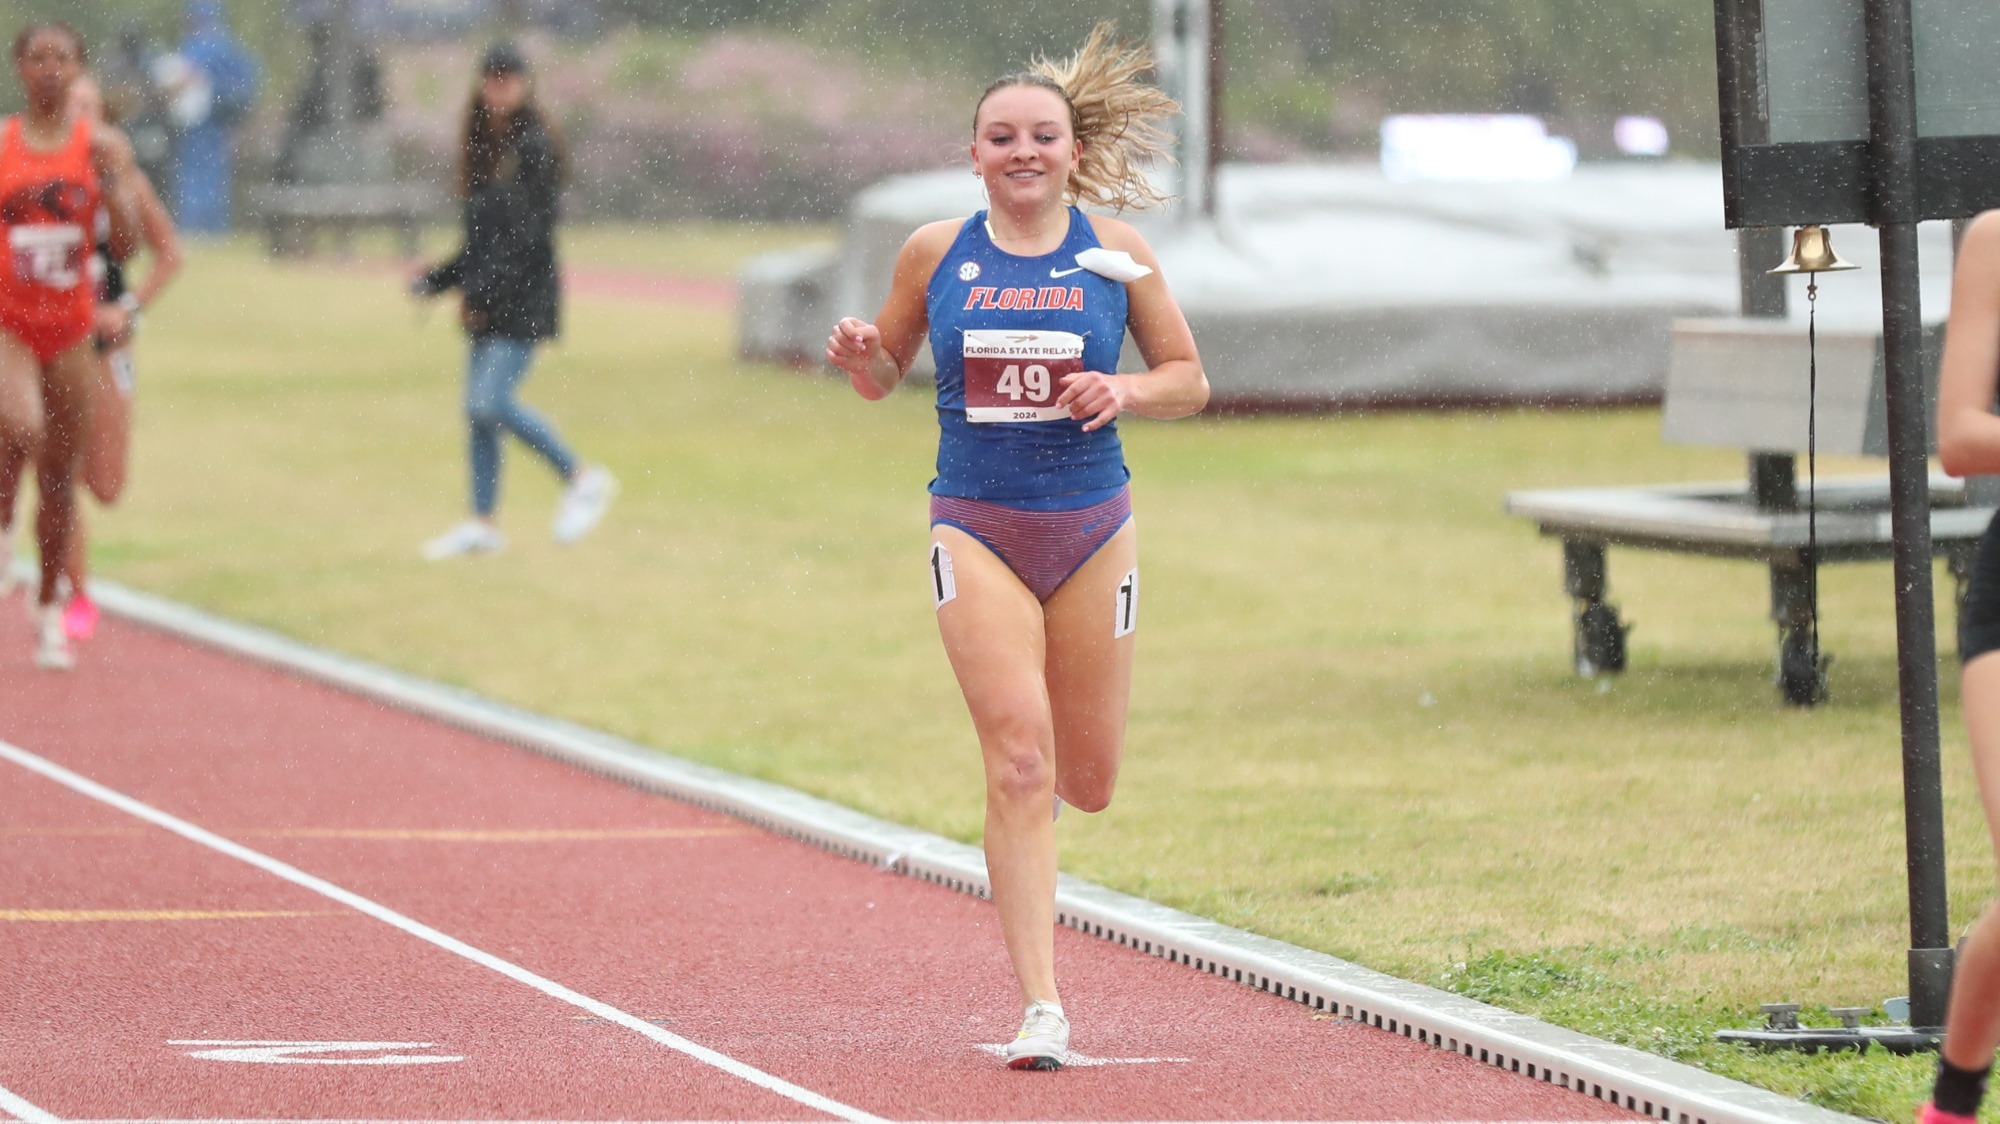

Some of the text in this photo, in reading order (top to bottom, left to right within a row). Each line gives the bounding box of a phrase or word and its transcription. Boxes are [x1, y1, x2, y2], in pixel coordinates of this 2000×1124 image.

[958, 261, 981, 281] SEC
[963, 286, 1084, 311] FLORIDA
[965, 346, 1080, 355] FLORIDA STATE RELAYS
[996, 364, 1050, 402] 49
[1013, 411, 1037, 419] 2024
[931, 546, 944, 602] 1
[1120, 574, 1133, 630] 1
